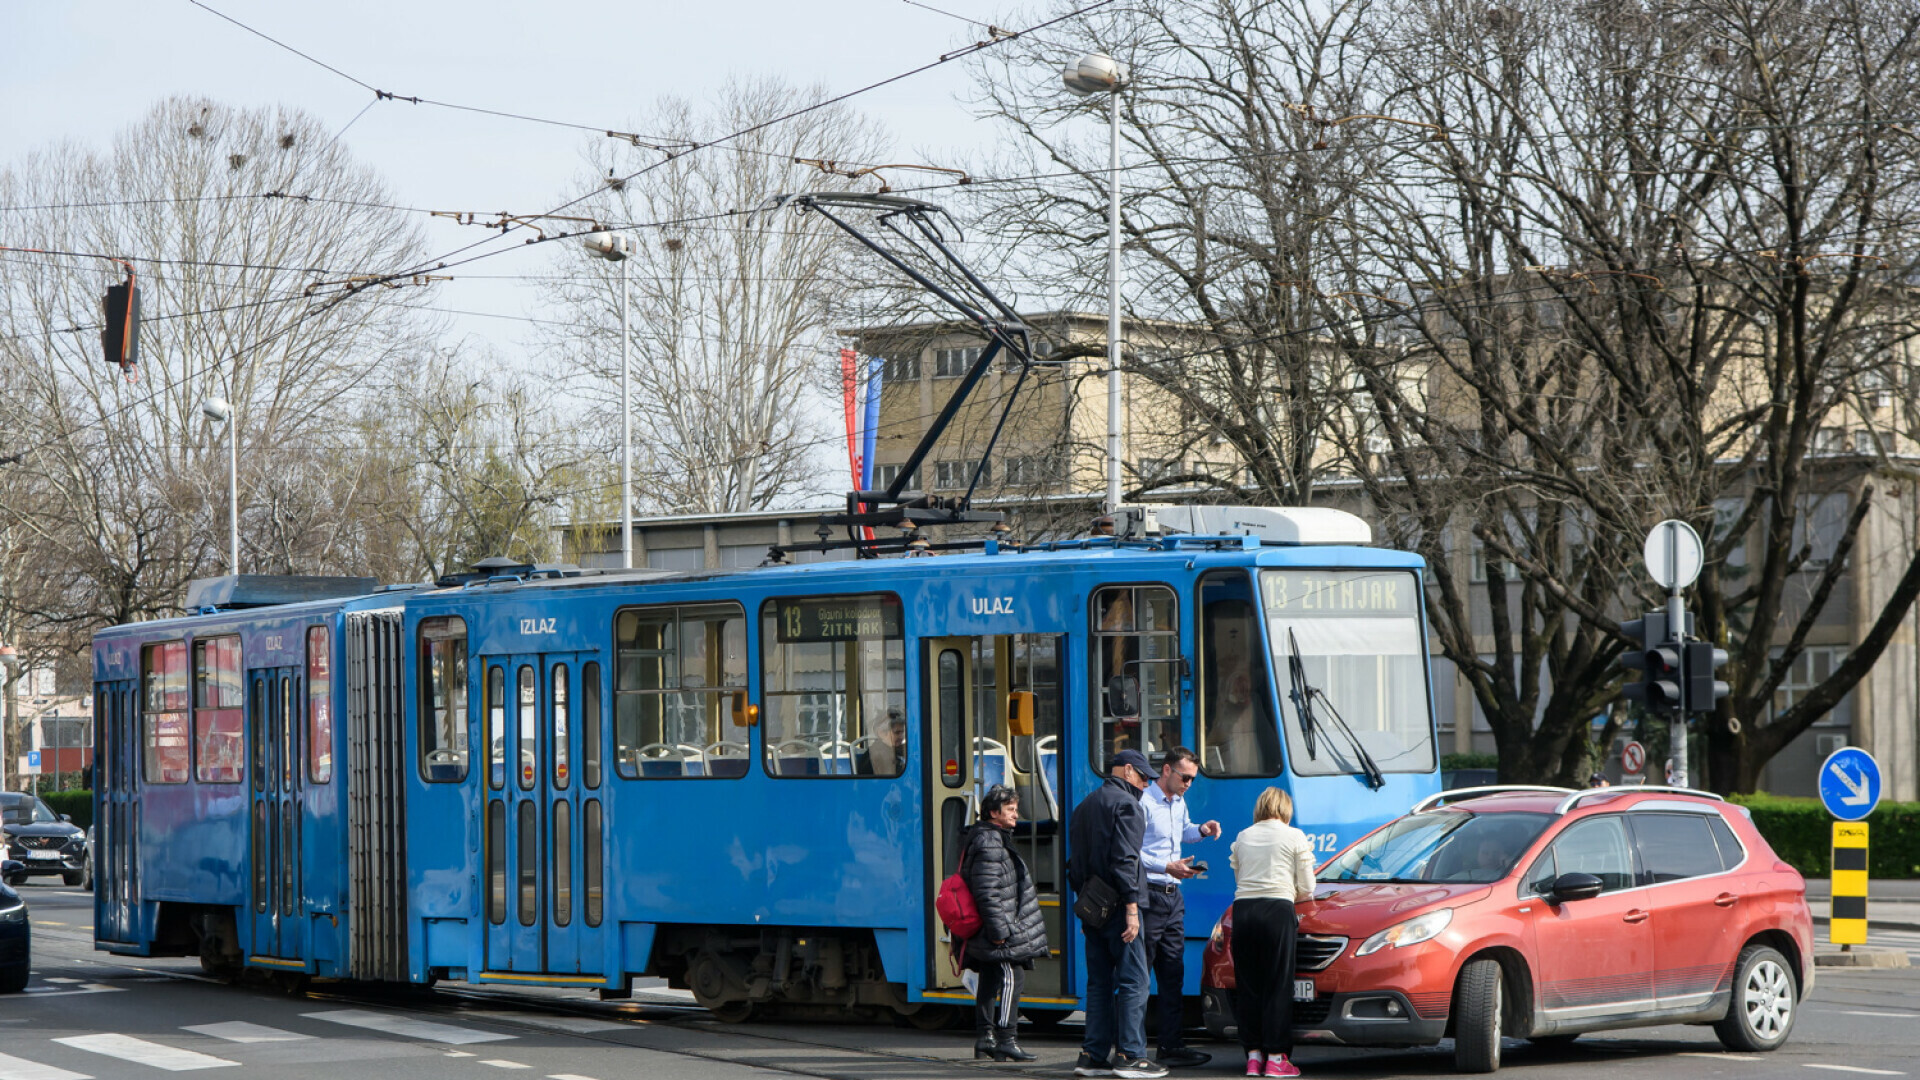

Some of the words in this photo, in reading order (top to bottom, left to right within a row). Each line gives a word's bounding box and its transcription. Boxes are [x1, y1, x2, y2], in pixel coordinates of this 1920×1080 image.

[1265, 576, 1287, 609] 13
[1302, 577, 1397, 610] ŽITNJAK
[972, 597, 1014, 615] ULAZ
[520, 617, 557, 635] IZLAZ
[784, 606, 801, 638] 13
[821, 622, 879, 637] ŽITNJAK
[265, 635, 283, 651] IZLAZ
[31, 753, 38, 765] P
